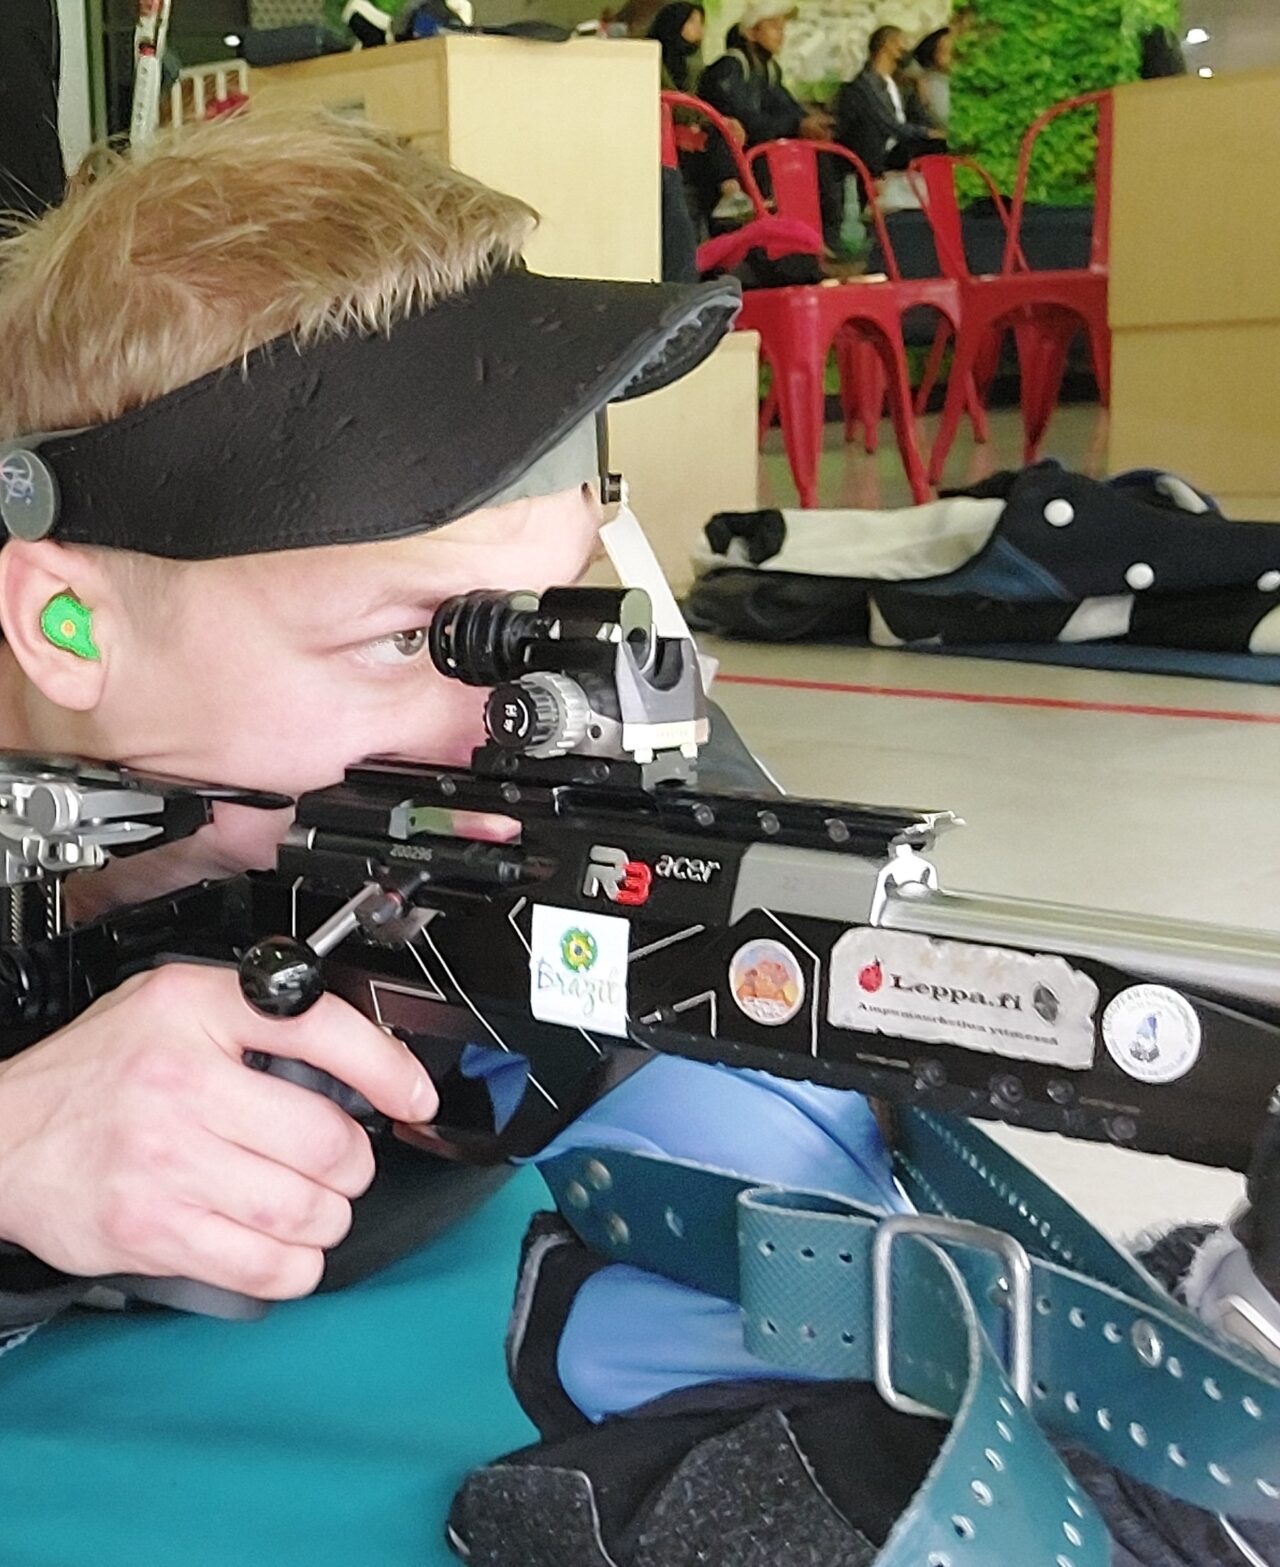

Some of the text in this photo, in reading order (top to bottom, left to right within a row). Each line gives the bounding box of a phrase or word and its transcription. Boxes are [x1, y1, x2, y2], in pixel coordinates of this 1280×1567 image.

[582, 844, 721, 905] R3 acer
[536, 957, 621, 1018] Brazil
[889, 973, 1023, 1012] Leppa.fi
